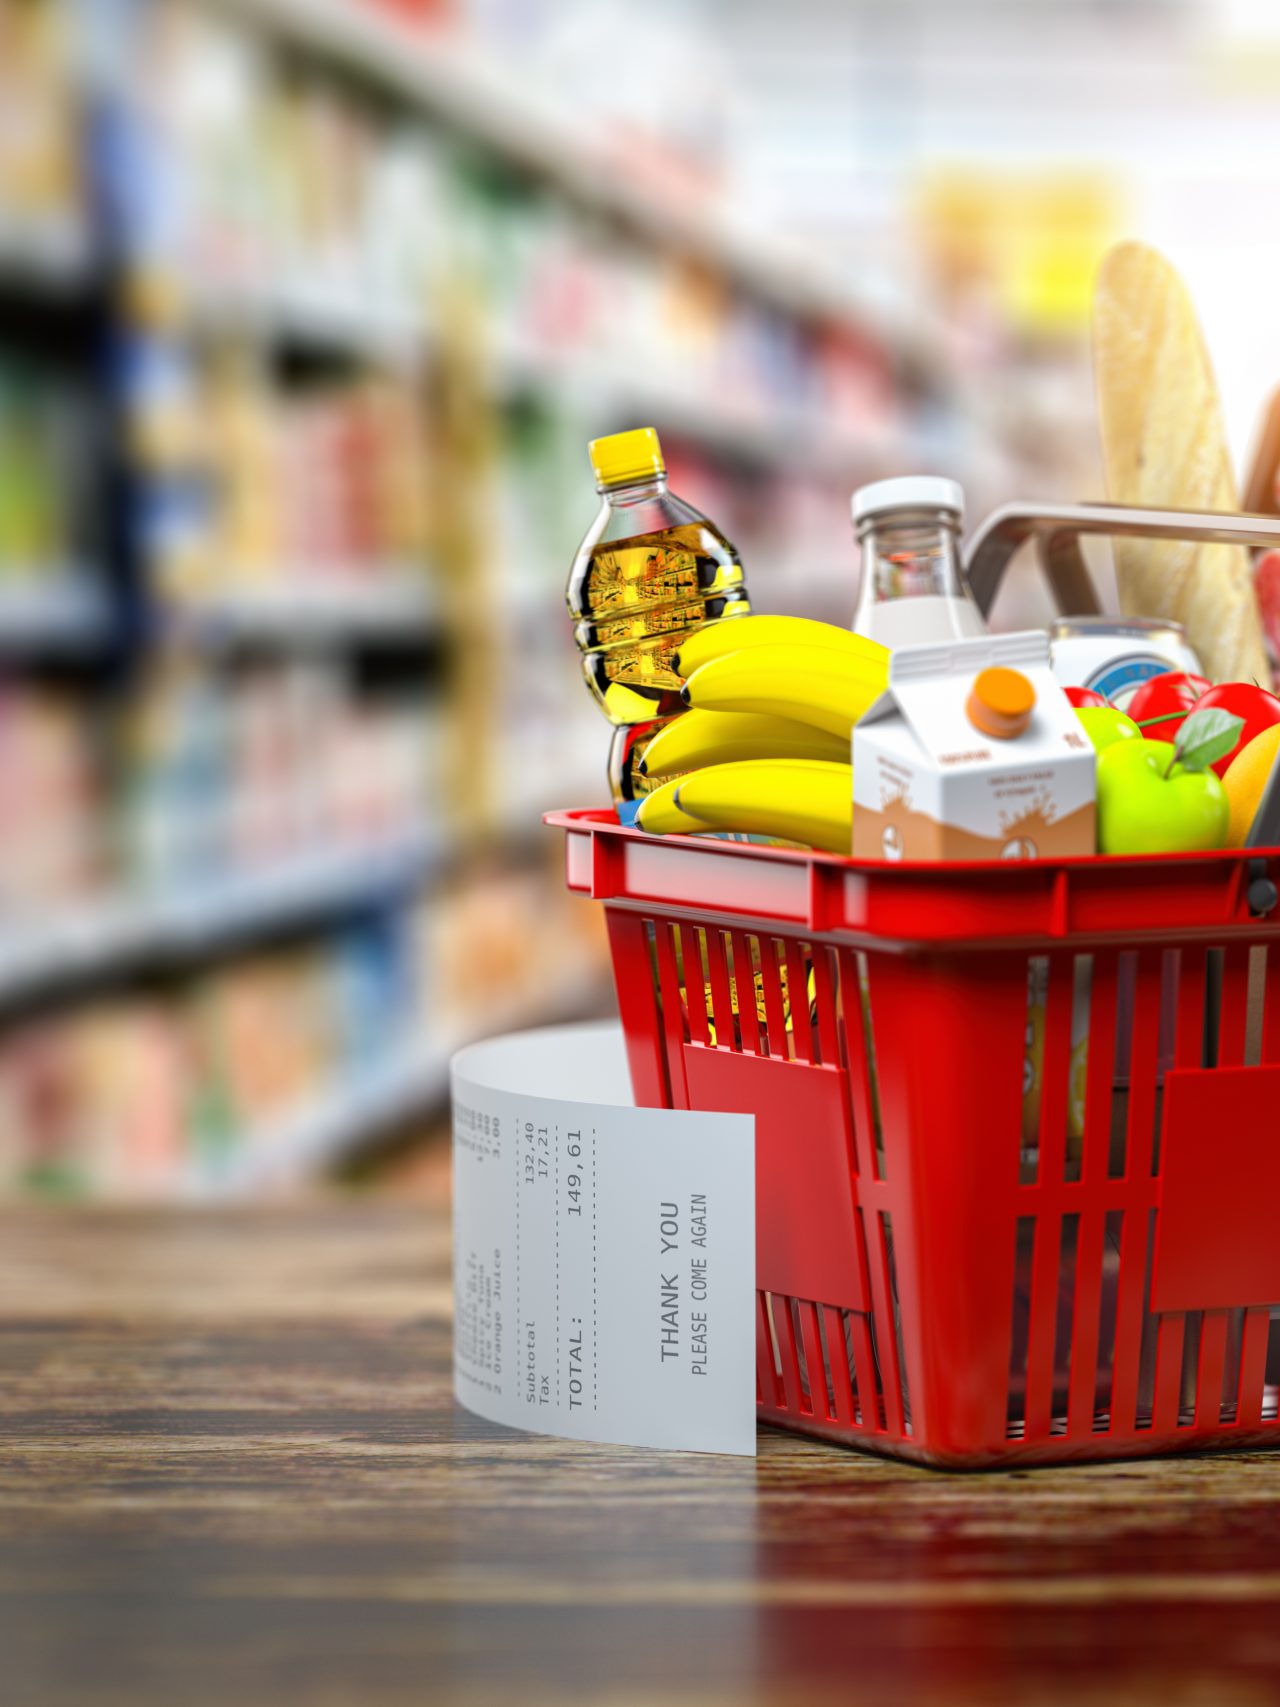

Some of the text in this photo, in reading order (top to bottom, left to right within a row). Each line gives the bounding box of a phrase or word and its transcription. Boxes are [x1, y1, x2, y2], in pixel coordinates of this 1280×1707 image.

[492, 1117, 501, 1160] 3,00
[492, 1247, 502, 1301] Juice
[493, 1311, 502, 1374] Orange
[524, 1122, 536, 1403] Subtotal 132,40
[537, 1127, 550, 1406] Tax 17,21
[567, 1129, 584, 1411] TOTAL: 149,61
[659, 1202, 680, 1363] THANK YOU
[690, 1194, 708, 1376] PLEASE COME AGAIN
